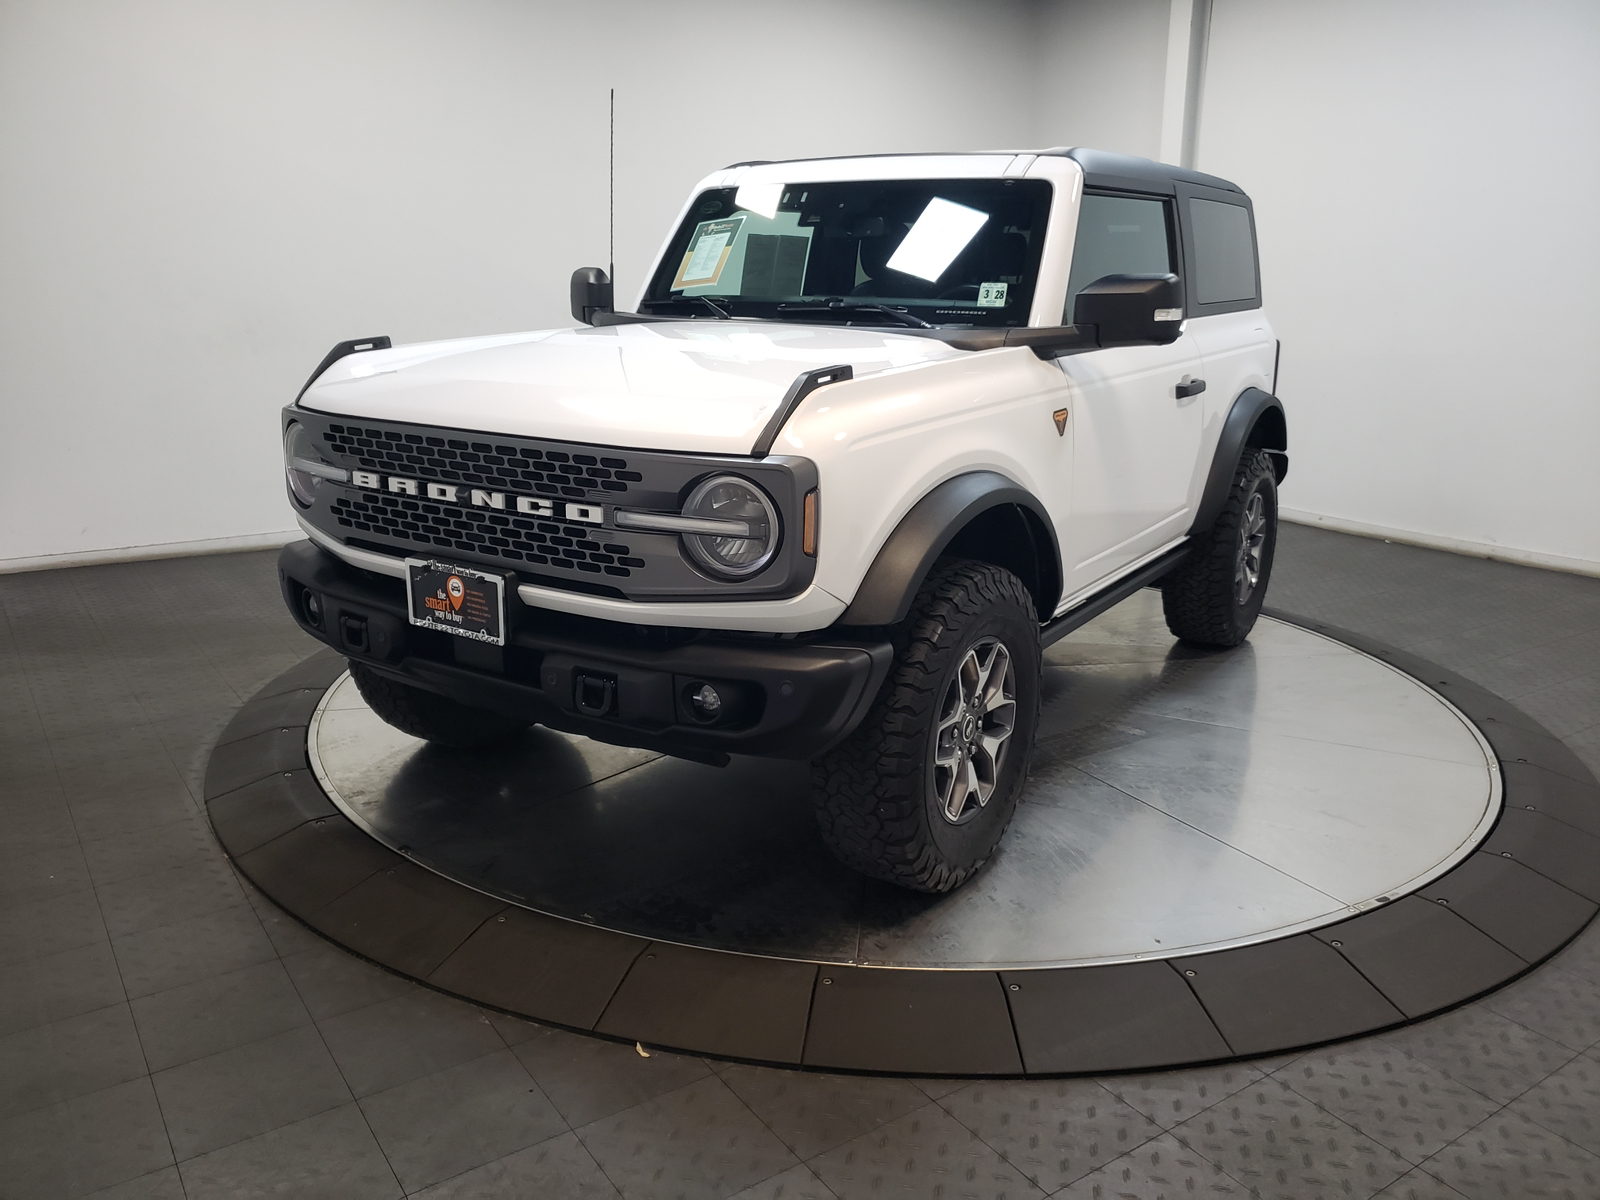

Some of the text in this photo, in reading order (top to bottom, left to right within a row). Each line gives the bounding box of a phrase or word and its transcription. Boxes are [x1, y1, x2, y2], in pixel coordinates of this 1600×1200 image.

[983, 289, 1005, 300] 3 28
[352, 470, 604, 524] BRONCO
[437, 588, 446, 600] the
[425, 596, 451, 612] smart
[434, 610, 445, 621] way
[445, 610, 452, 621] to
[452, 610, 463, 625] buy
